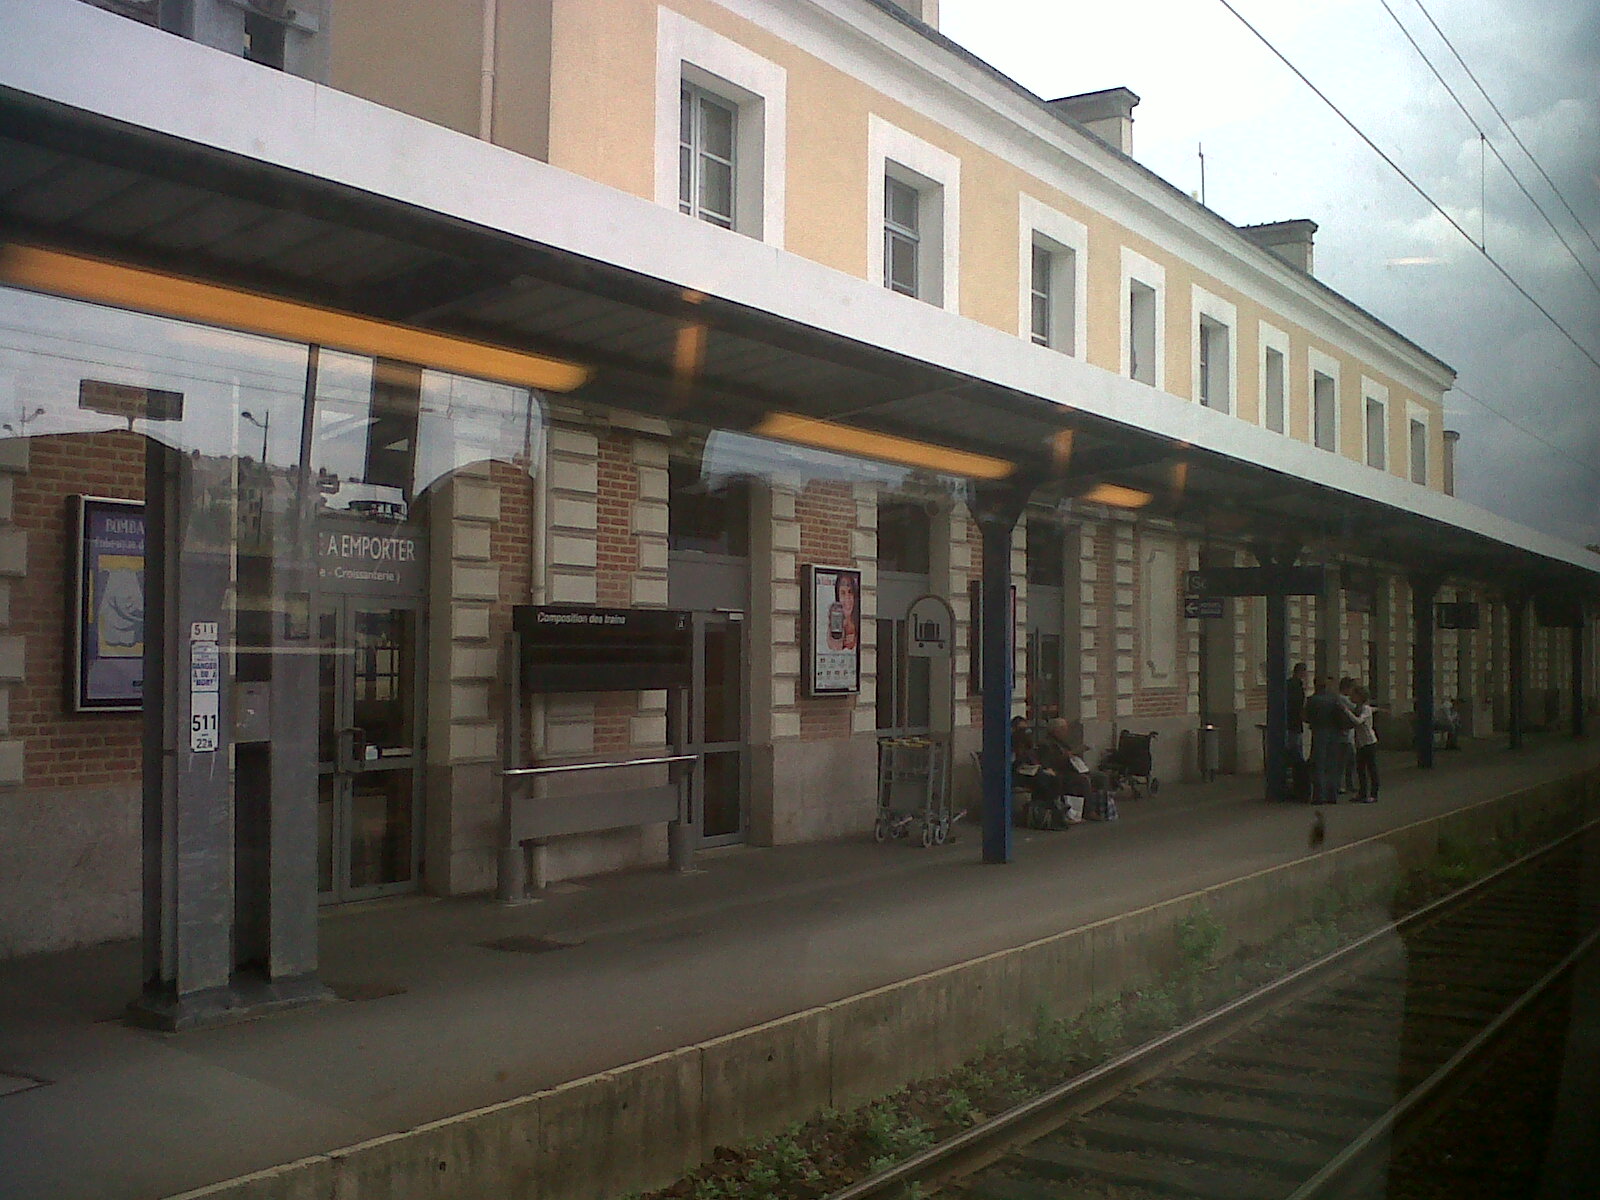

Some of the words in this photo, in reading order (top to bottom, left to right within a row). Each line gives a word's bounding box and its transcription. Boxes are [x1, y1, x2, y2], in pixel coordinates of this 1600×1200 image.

[327, 535, 339, 556] A
[341, 534, 415, 561] EMPORTER
[537, 611, 588, 624] Composition
[589, 614, 603, 624] des
[604, 613, 626, 624] trains
[194, 624, 214, 636] 511
[192, 714, 216, 731] 511
